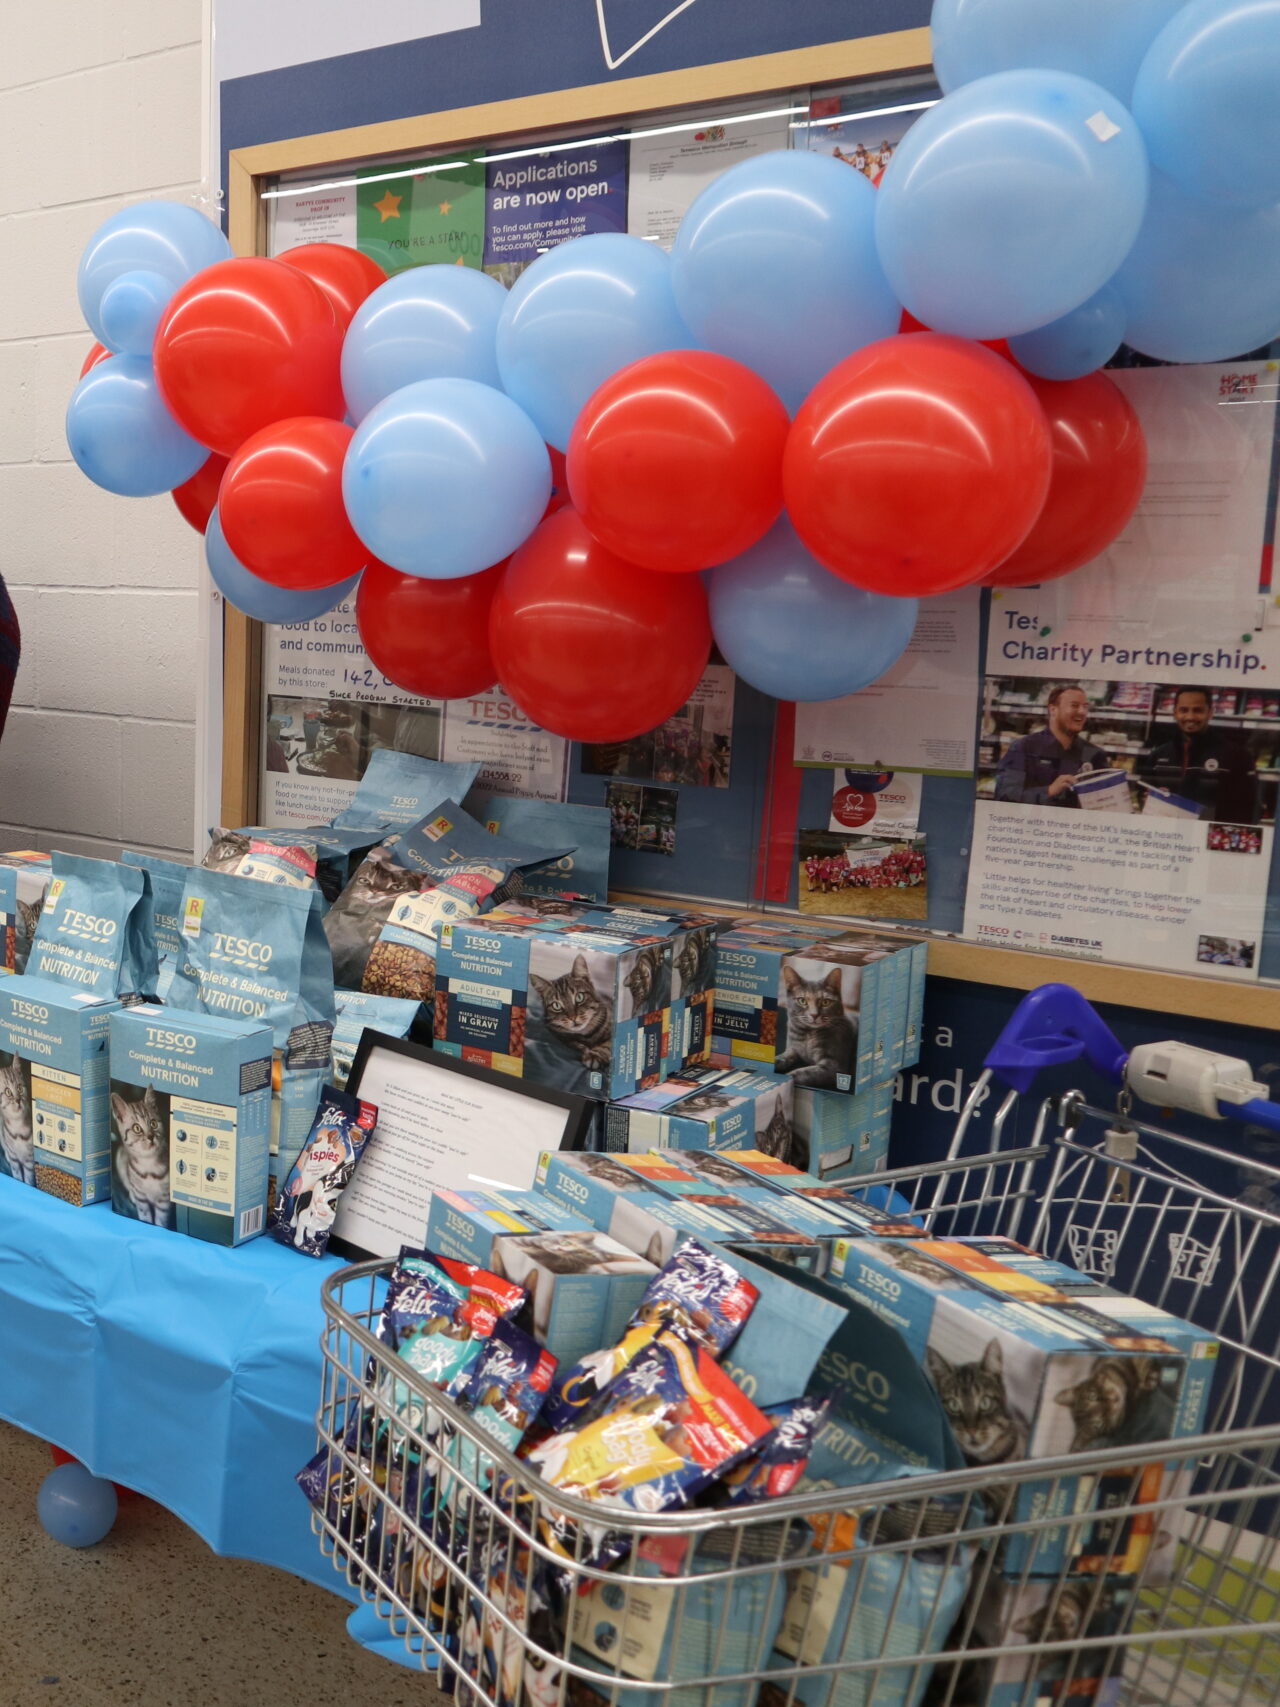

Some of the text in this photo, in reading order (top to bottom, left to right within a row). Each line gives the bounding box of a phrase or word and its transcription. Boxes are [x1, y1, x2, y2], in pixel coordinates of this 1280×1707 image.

[493, 160, 598, 189] Applications
[493, 189, 561, 211] are now
[492, 216, 586, 234] To find out more and how
[492, 236, 506, 244] you
[545, 228, 570, 238] please
[571, 224, 586, 232] visit
[388, 236, 426, 251] YOU'RE
[428, 235, 436, 245] A
[313, 619, 328, 633] to
[280, 638, 303, 651] and
[1002, 640, 1267, 675] Charity Partnership.
[278, 664, 336, 677] Meals donated
[278, 677, 328, 689] by this store:
[329, 690, 432, 706] SINCE STARTED
[275, 790, 290, 798] food
[293, 783, 310, 791] know
[310, 785, 322, 793] any
[275, 799, 286, 807] like
[286, 800, 304, 809] lunch
[304, 803, 322, 812] clubs
[879, 793, 907, 802] TESCO
[988, 813, 1098, 832] Together with three the
[986, 833, 1091, 852] Foundation and Diabetes
[987, 825, 1107, 842] charities Cancer Research
[1018, 848, 1160, 870] biggest health challenges part
[53, 881, 62, 894] R
[1008, 875, 1202, 905] helps for healthier brings together the
[190, 899, 200, 913] R
[979, 892, 1065, 909] the risk heart and
[981, 882, 1193, 914] skills and expertise the help lower
[979, 902, 1017, 915] and Type
[62, 909, 117, 937] TESCO
[977, 924, 1010, 937] TESCO
[37, 939, 82, 961] Complete &
[213, 932, 273, 963] TESCO
[464, 935, 502, 952] TESCO
[451, 950, 480, 963] Complete
[485, 956, 513, 968] Balanced
[718, 950, 757, 967] TESCO
[39, 956, 100, 985] NUTRITION
[460, 960, 503, 977] NUTRITION
[740, 971, 769, 982] Balanced
[183, 963, 289, 1002] Complete & Balanced
[460, 983, 501, 998] ADULT CAT
[714, 976, 758, 990] NUTRITION
[11, 998, 49, 1020] TESCO
[196, 984, 266, 1017] NUTRITION
[0, 1018, 63, 1045] Complete & Balanced
[458, 1015, 499, 1030] IN GRAVY
[714, 1016, 749, 1030] IN JELLY
[9, 1034, 52, 1056] NUTRITION
[145, 1027, 197, 1050] TESCO
[935, 1025, 953, 1048] a
[128, 1050, 214, 1076] Complete & Balanced
[41, 1068, 67, 1083] KITTEN
[140, 1064, 200, 1088] NUTRITION
[317, 1105, 347, 1128] felix
[722, 1113, 742, 1131] TESCO
[558, 1172, 589, 1200] TESCO
[446, 1209, 476, 1240] TESCO
[860, 1264, 902, 1298] TESCO
[392, 1286, 437, 1314] felix
